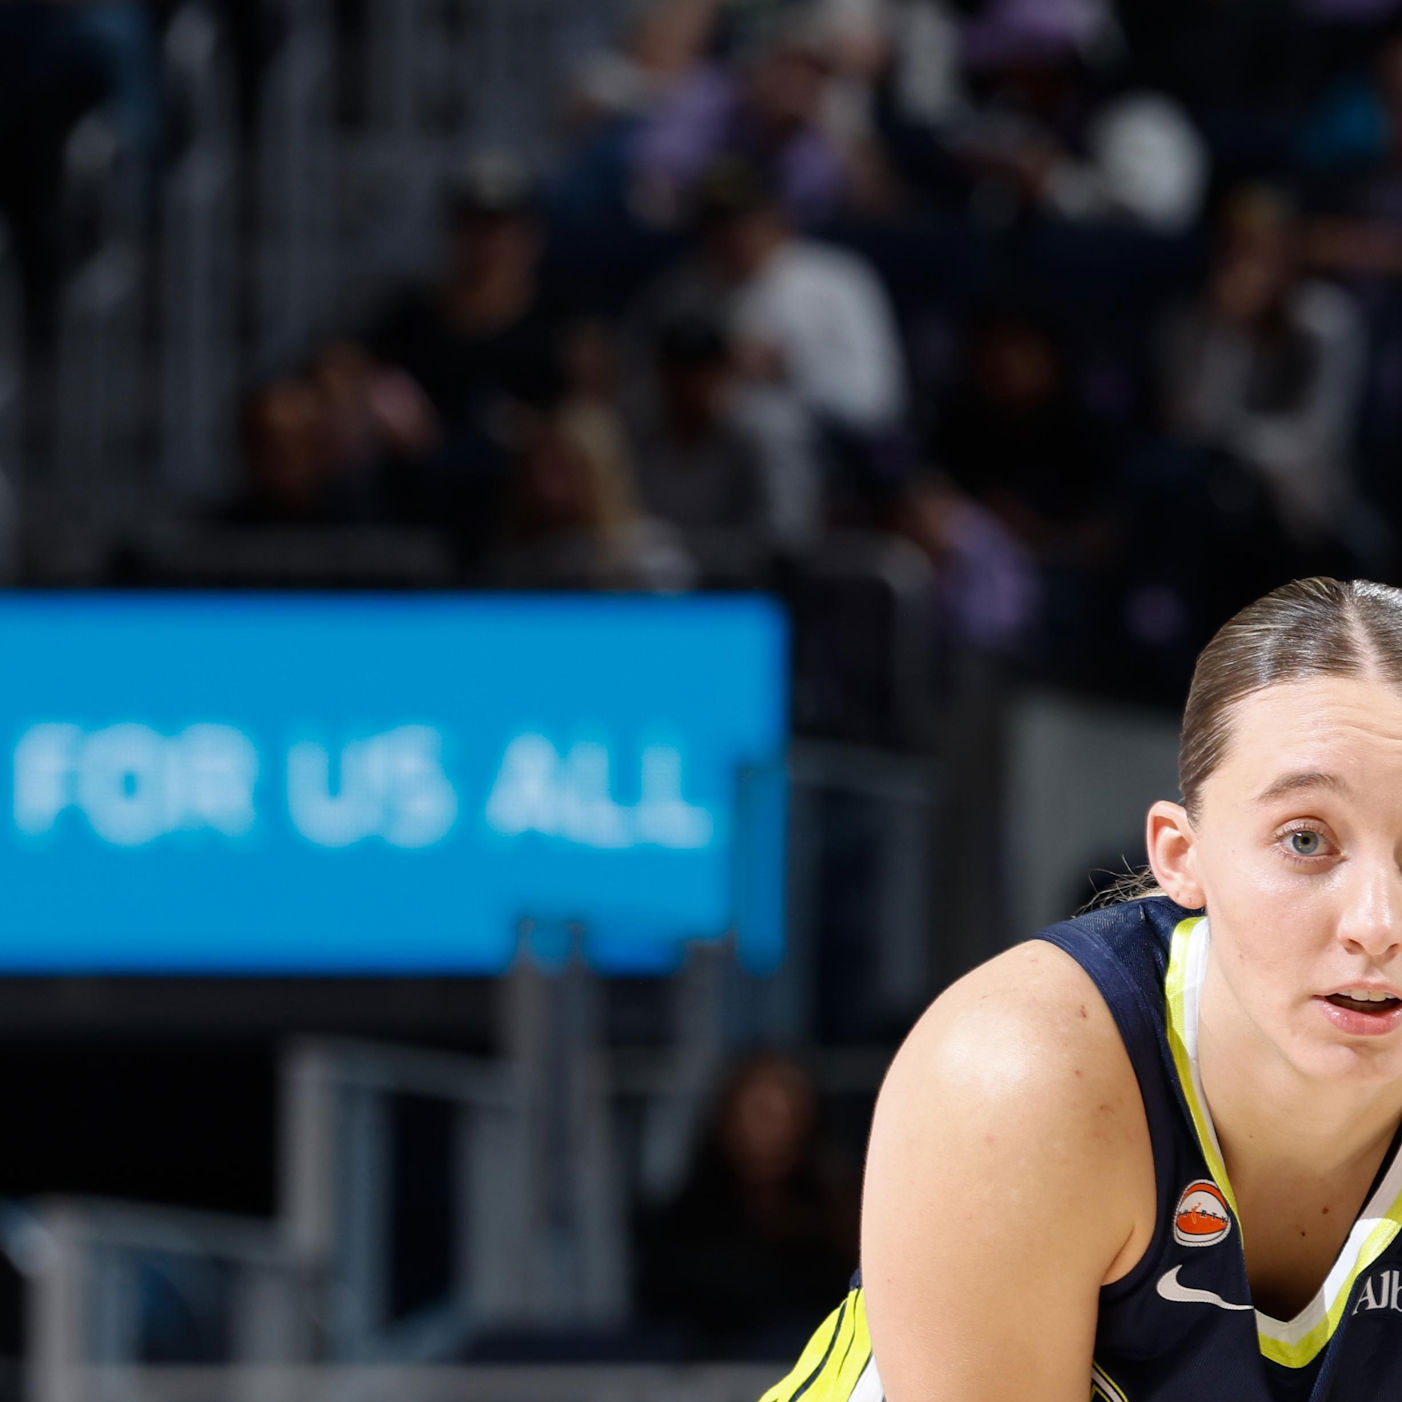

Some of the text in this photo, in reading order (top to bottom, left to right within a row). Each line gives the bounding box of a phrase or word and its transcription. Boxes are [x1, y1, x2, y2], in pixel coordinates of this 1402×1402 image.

[14, 722, 714, 849] FOR US ALL
